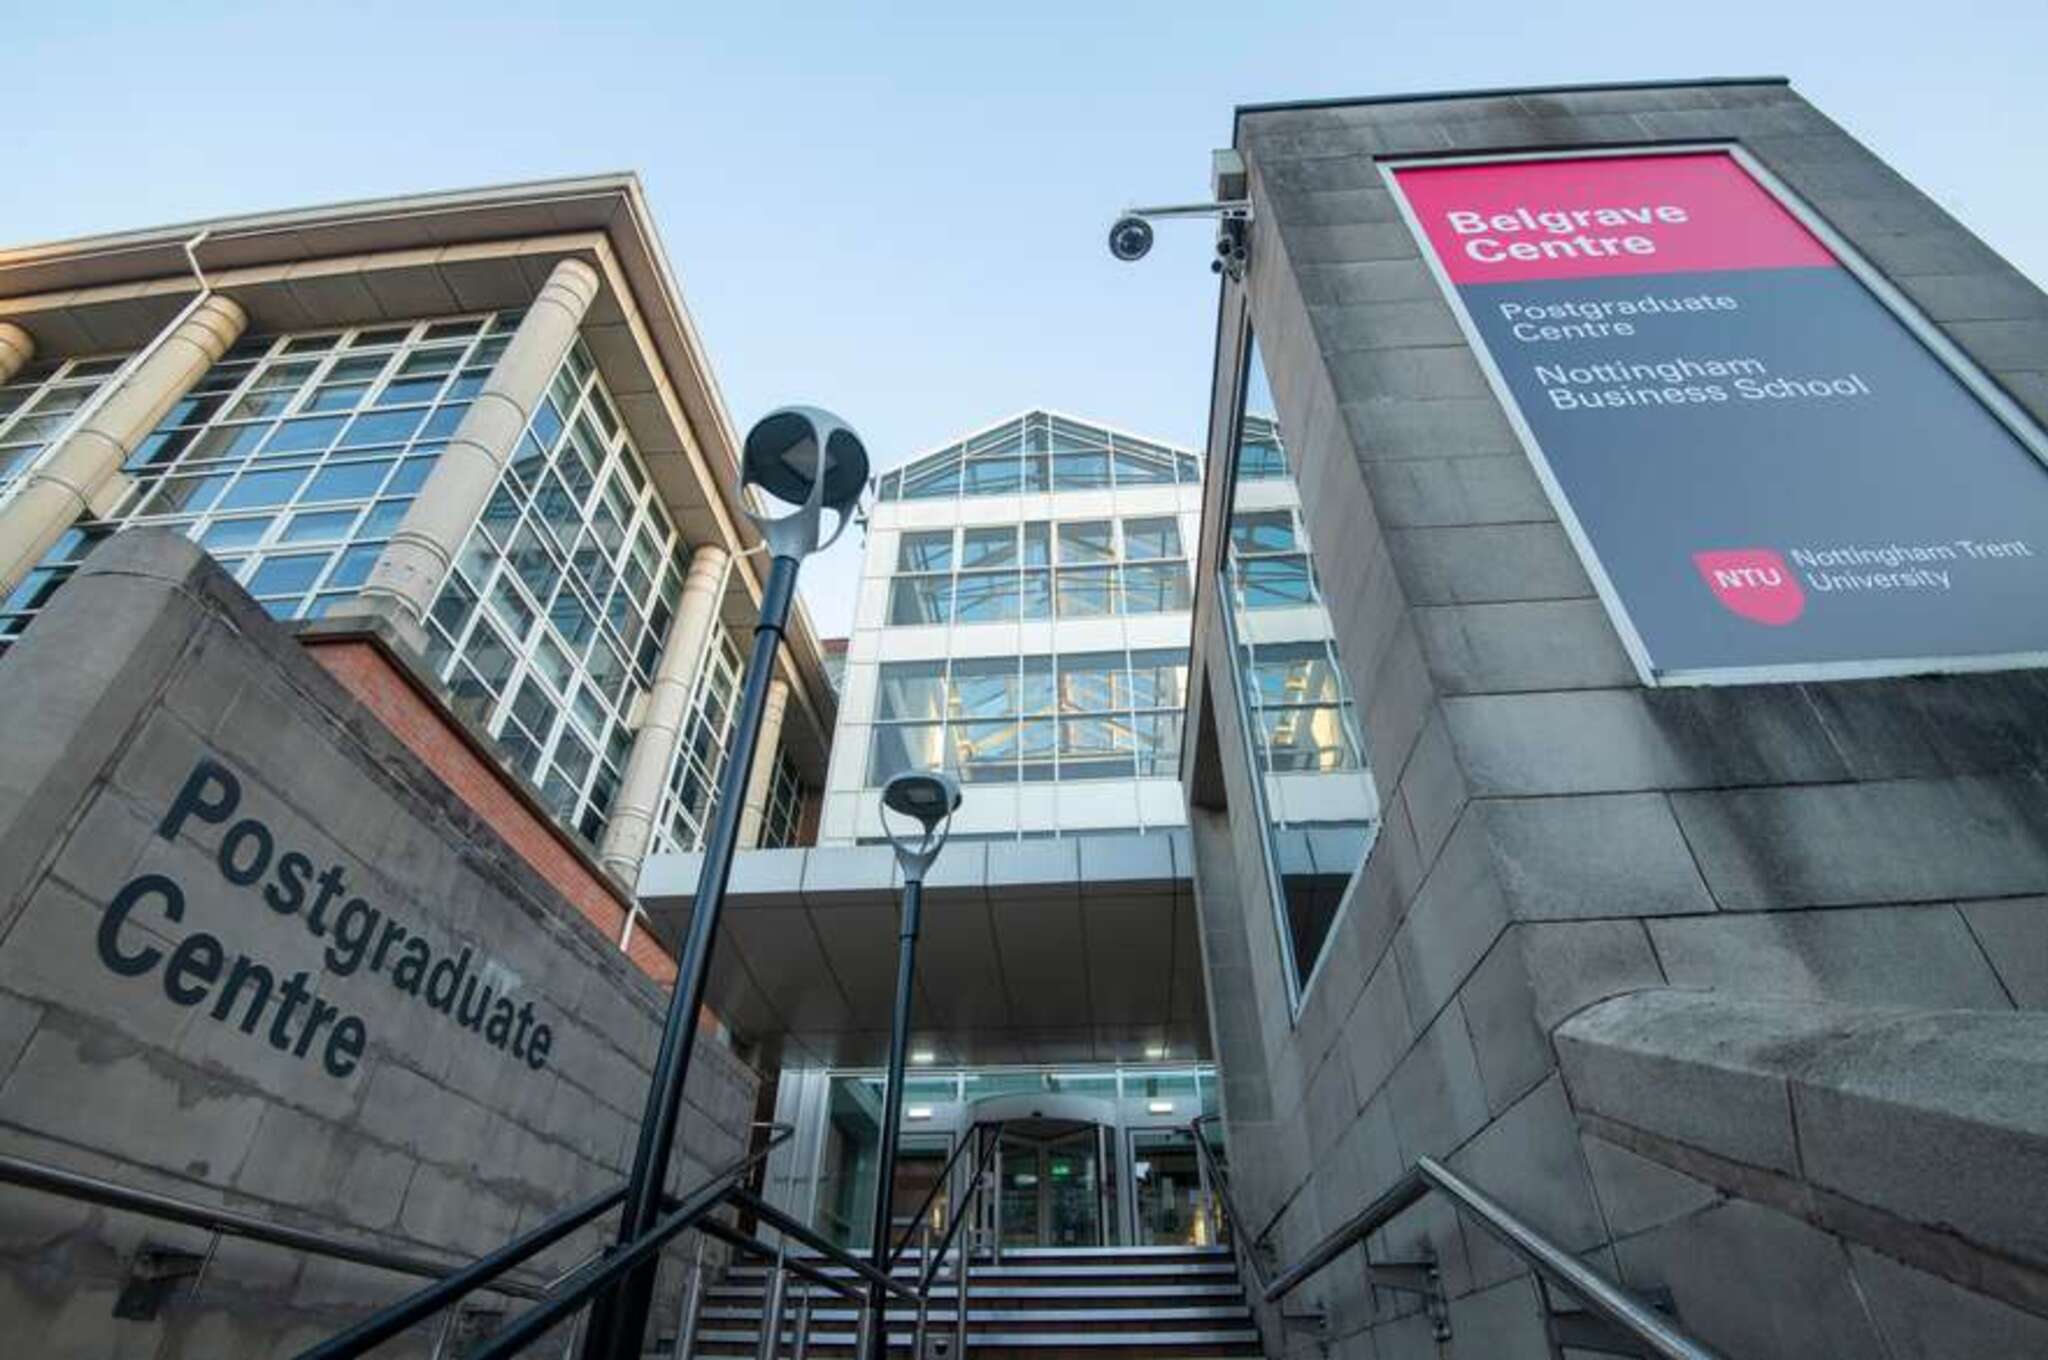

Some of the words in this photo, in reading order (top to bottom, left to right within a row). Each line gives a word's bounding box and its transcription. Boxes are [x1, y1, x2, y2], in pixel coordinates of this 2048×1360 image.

[1447, 205, 1688, 234] Belgrave
[1466, 235, 1656, 262] Centre
[1500, 296, 1739, 321] Postgraduate
[1512, 320, 1635, 342] Centre
[1535, 356, 1768, 386] Nottingham
[1549, 381, 1729, 410] Business
[1734, 374, 1872, 400] School
[1790, 543, 1955, 568] Nottingham
[1955, 540, 2033, 559] Trent
[1713, 567, 1782, 589] NTU
[1807, 566, 1951, 591] University
[157, 757, 553, 1070] Postgraduate
[98, 874, 367, 1078] Centre
